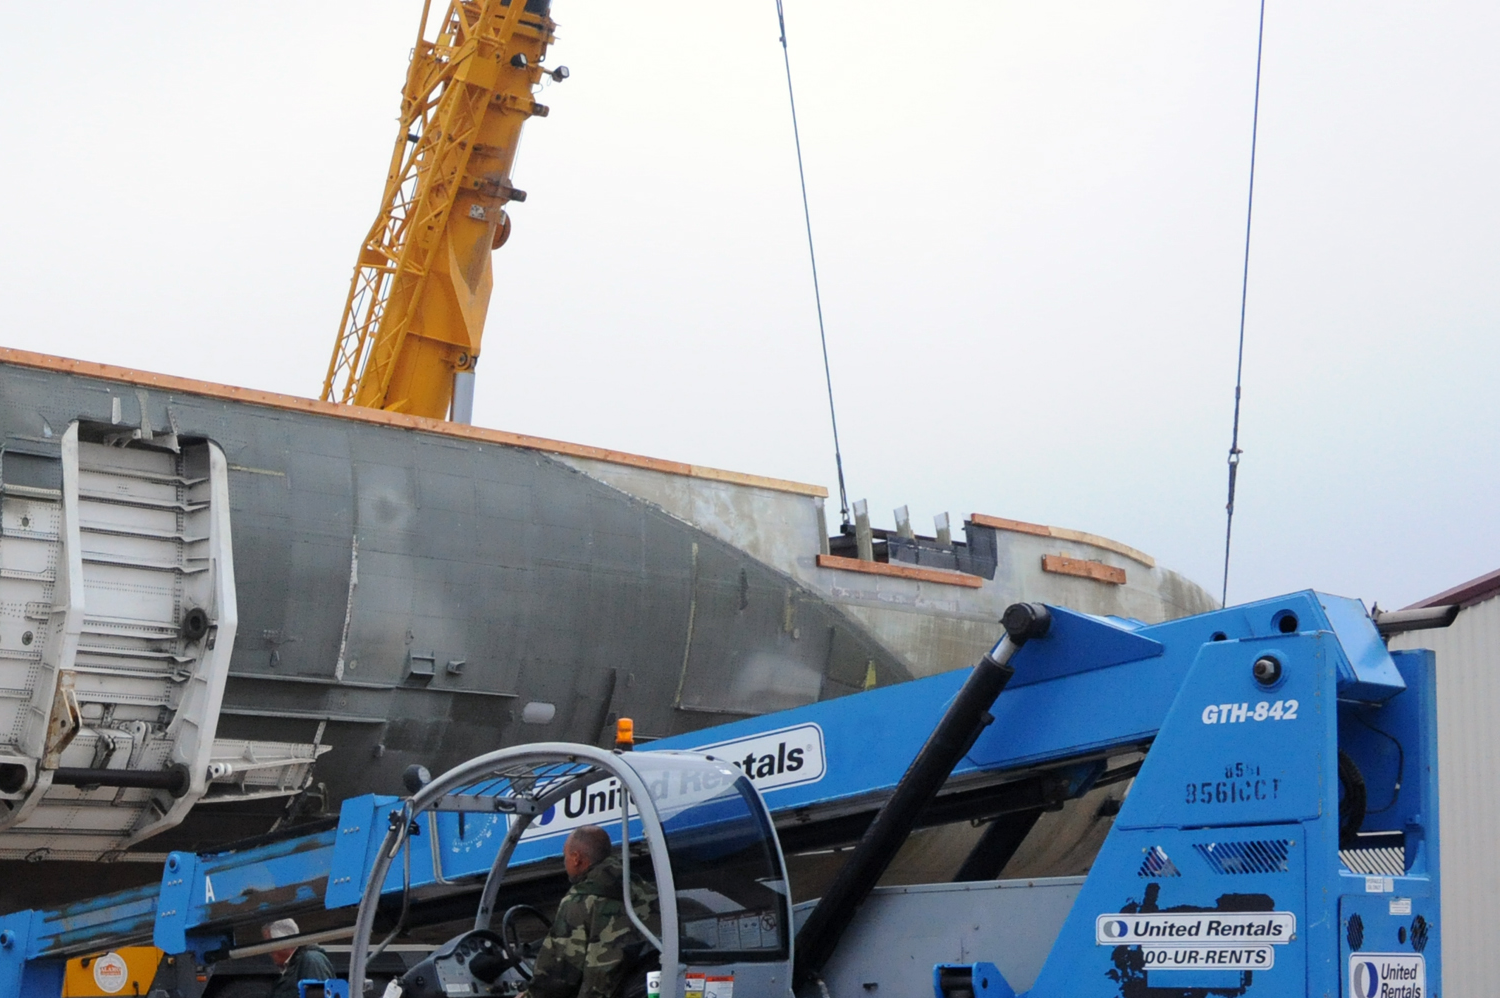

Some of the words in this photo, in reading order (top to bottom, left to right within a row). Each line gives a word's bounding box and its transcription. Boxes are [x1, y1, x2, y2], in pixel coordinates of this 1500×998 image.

[1201, 699, 1299, 724] GTH-842
[564, 771, 670, 819] Unitd
[205, 875, 216, 904] A
[1133, 920, 1202, 937] United
[1206, 920, 1283, 936] Rentals
[1145, 950, 1267, 965] 00-UR-RENTS
[1381, 963, 1417, 981] United
